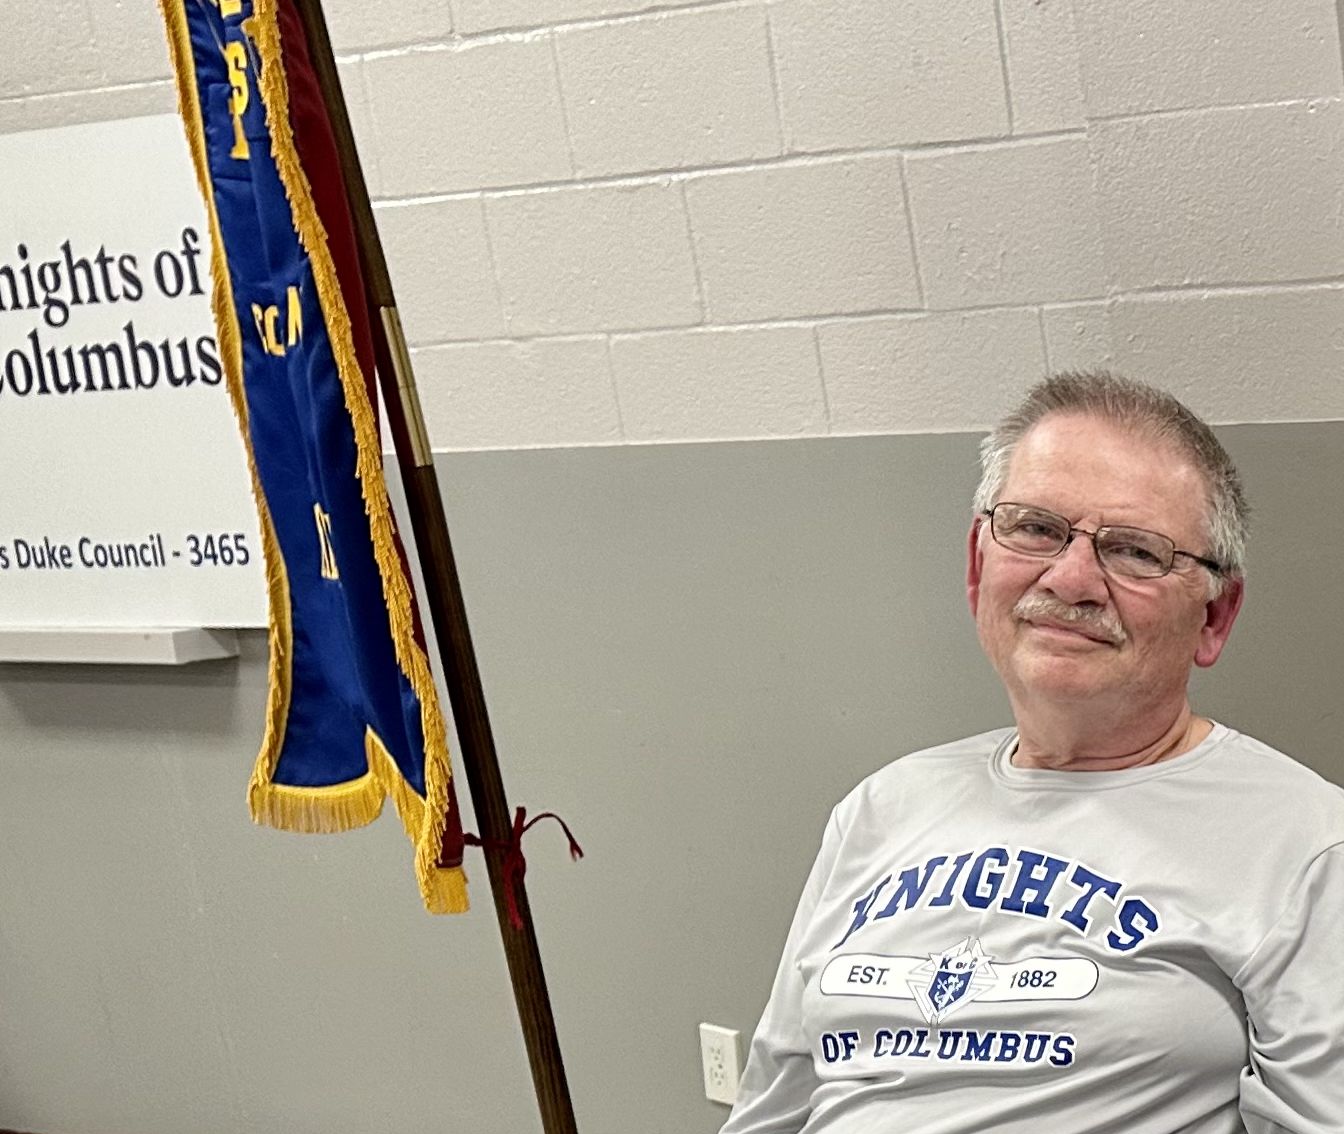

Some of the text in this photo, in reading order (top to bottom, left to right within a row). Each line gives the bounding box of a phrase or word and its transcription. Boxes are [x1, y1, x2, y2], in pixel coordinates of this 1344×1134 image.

[154, 227, 205, 298] of
[0, 320, 222, 397] olumbus
[14, 537, 73, 569] Duke
[79, 534, 166, 568] Council
[187, 534, 250, 566] 3465
[830, 847, 1160, 952] KNIGHTS
[847, 965, 1057, 989] EST. 1882
[822, 1029, 1076, 1067] OF COLUMBUS
